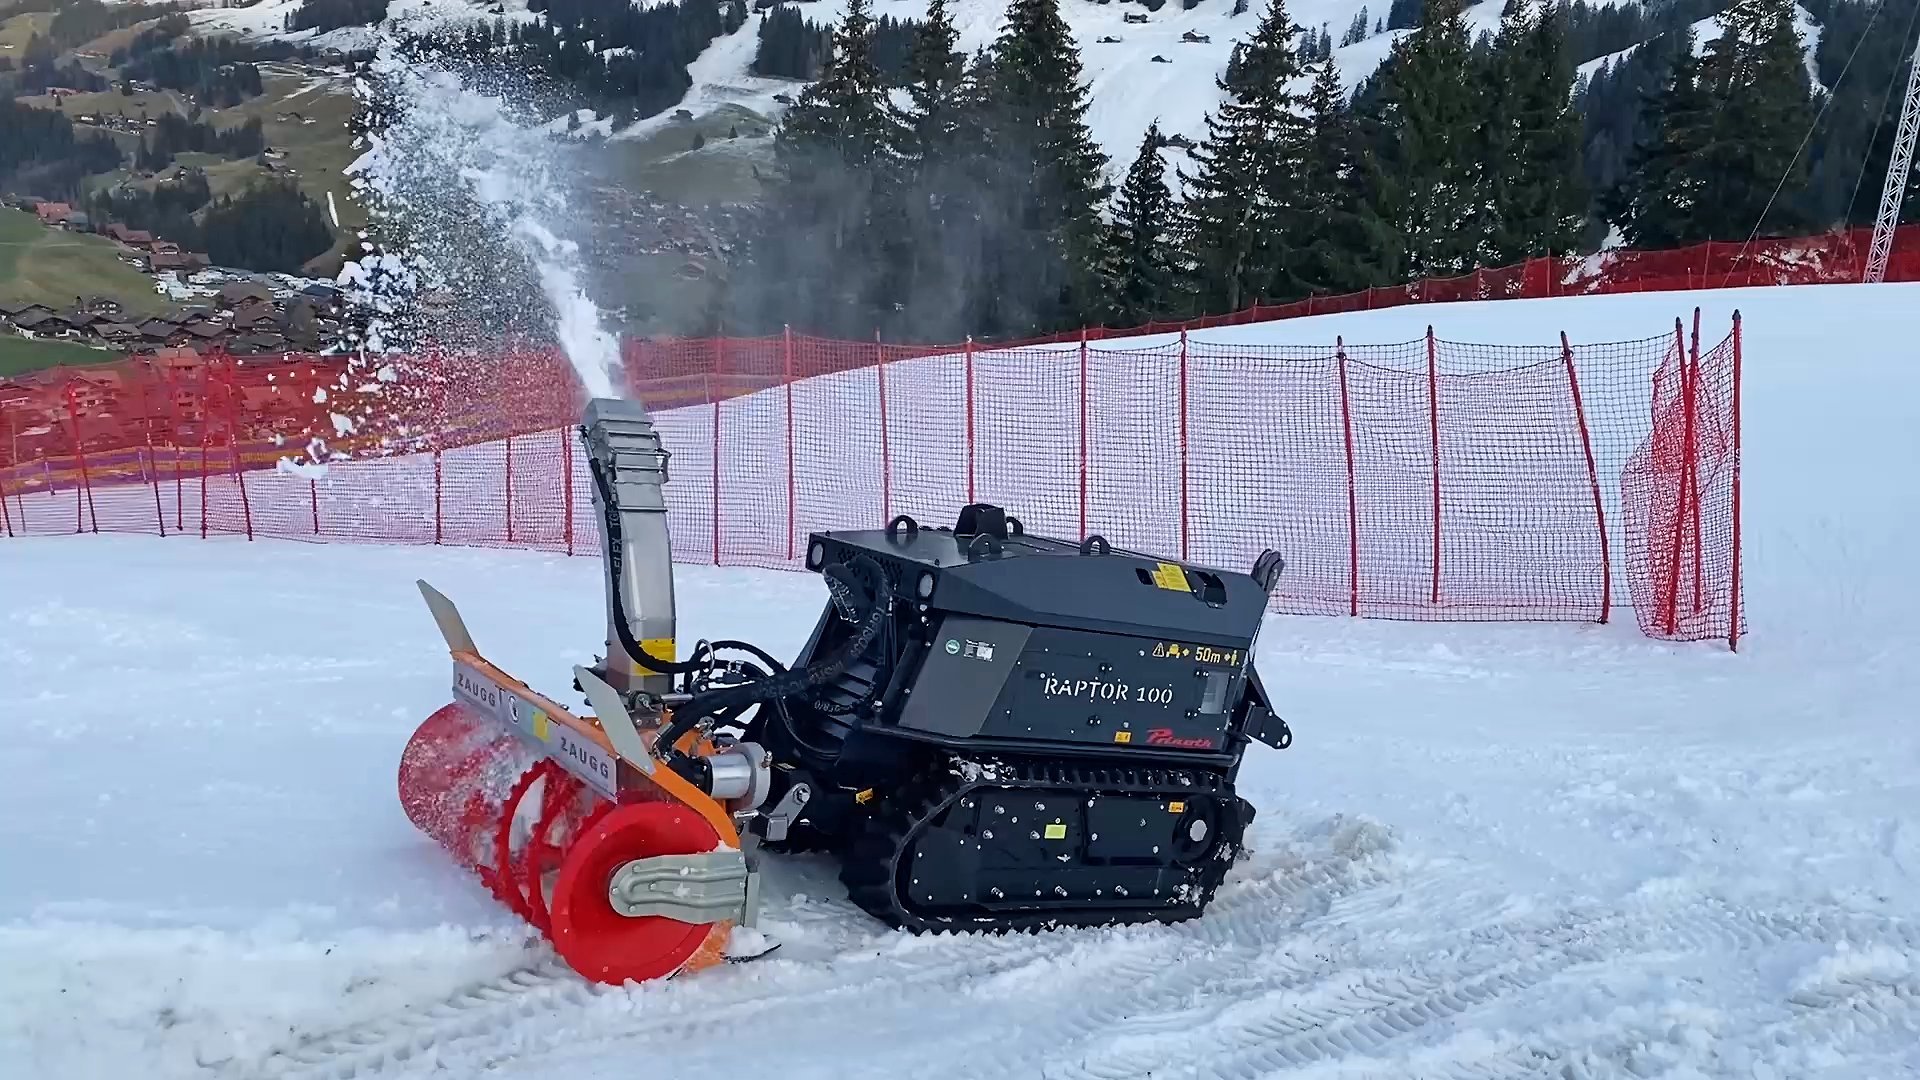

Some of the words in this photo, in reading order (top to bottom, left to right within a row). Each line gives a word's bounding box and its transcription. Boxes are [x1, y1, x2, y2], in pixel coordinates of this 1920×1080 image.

[1195, 646, 1221, 664] 50m
[457, 673, 496, 707] ZAUGG
[1044, 677, 1129, 701] RAPTOR
[1136, 687, 1173, 704] 100
[560, 736, 609, 779] ZAUGG
